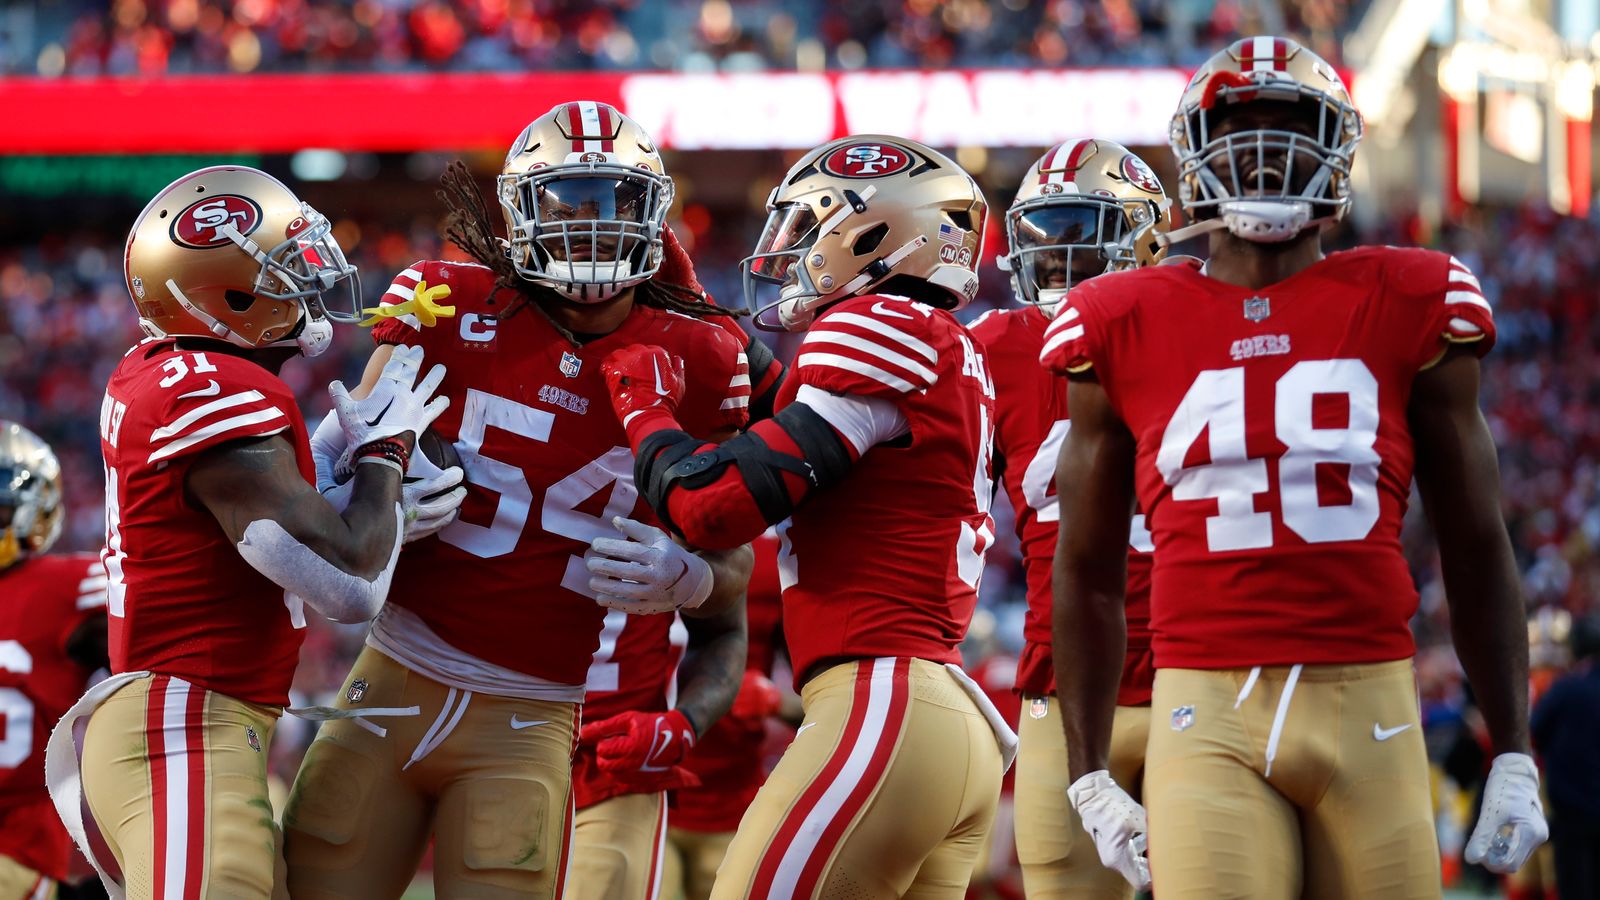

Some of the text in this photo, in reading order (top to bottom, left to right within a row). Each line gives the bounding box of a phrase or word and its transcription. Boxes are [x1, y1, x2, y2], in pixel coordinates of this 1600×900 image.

[845, 145, 899, 175] SF
[191, 200, 248, 242] SF
[941, 247, 956, 261] JM
[959, 250, 970, 265] 39
[459, 313, 497, 342] C
[1230, 334, 1291, 361] 49ERS
[159, 352, 218, 389] 31
[537, 384, 590, 415] 49ERS
[1155, 358, 1382, 552] 48
[438, 388, 640, 600] 54
